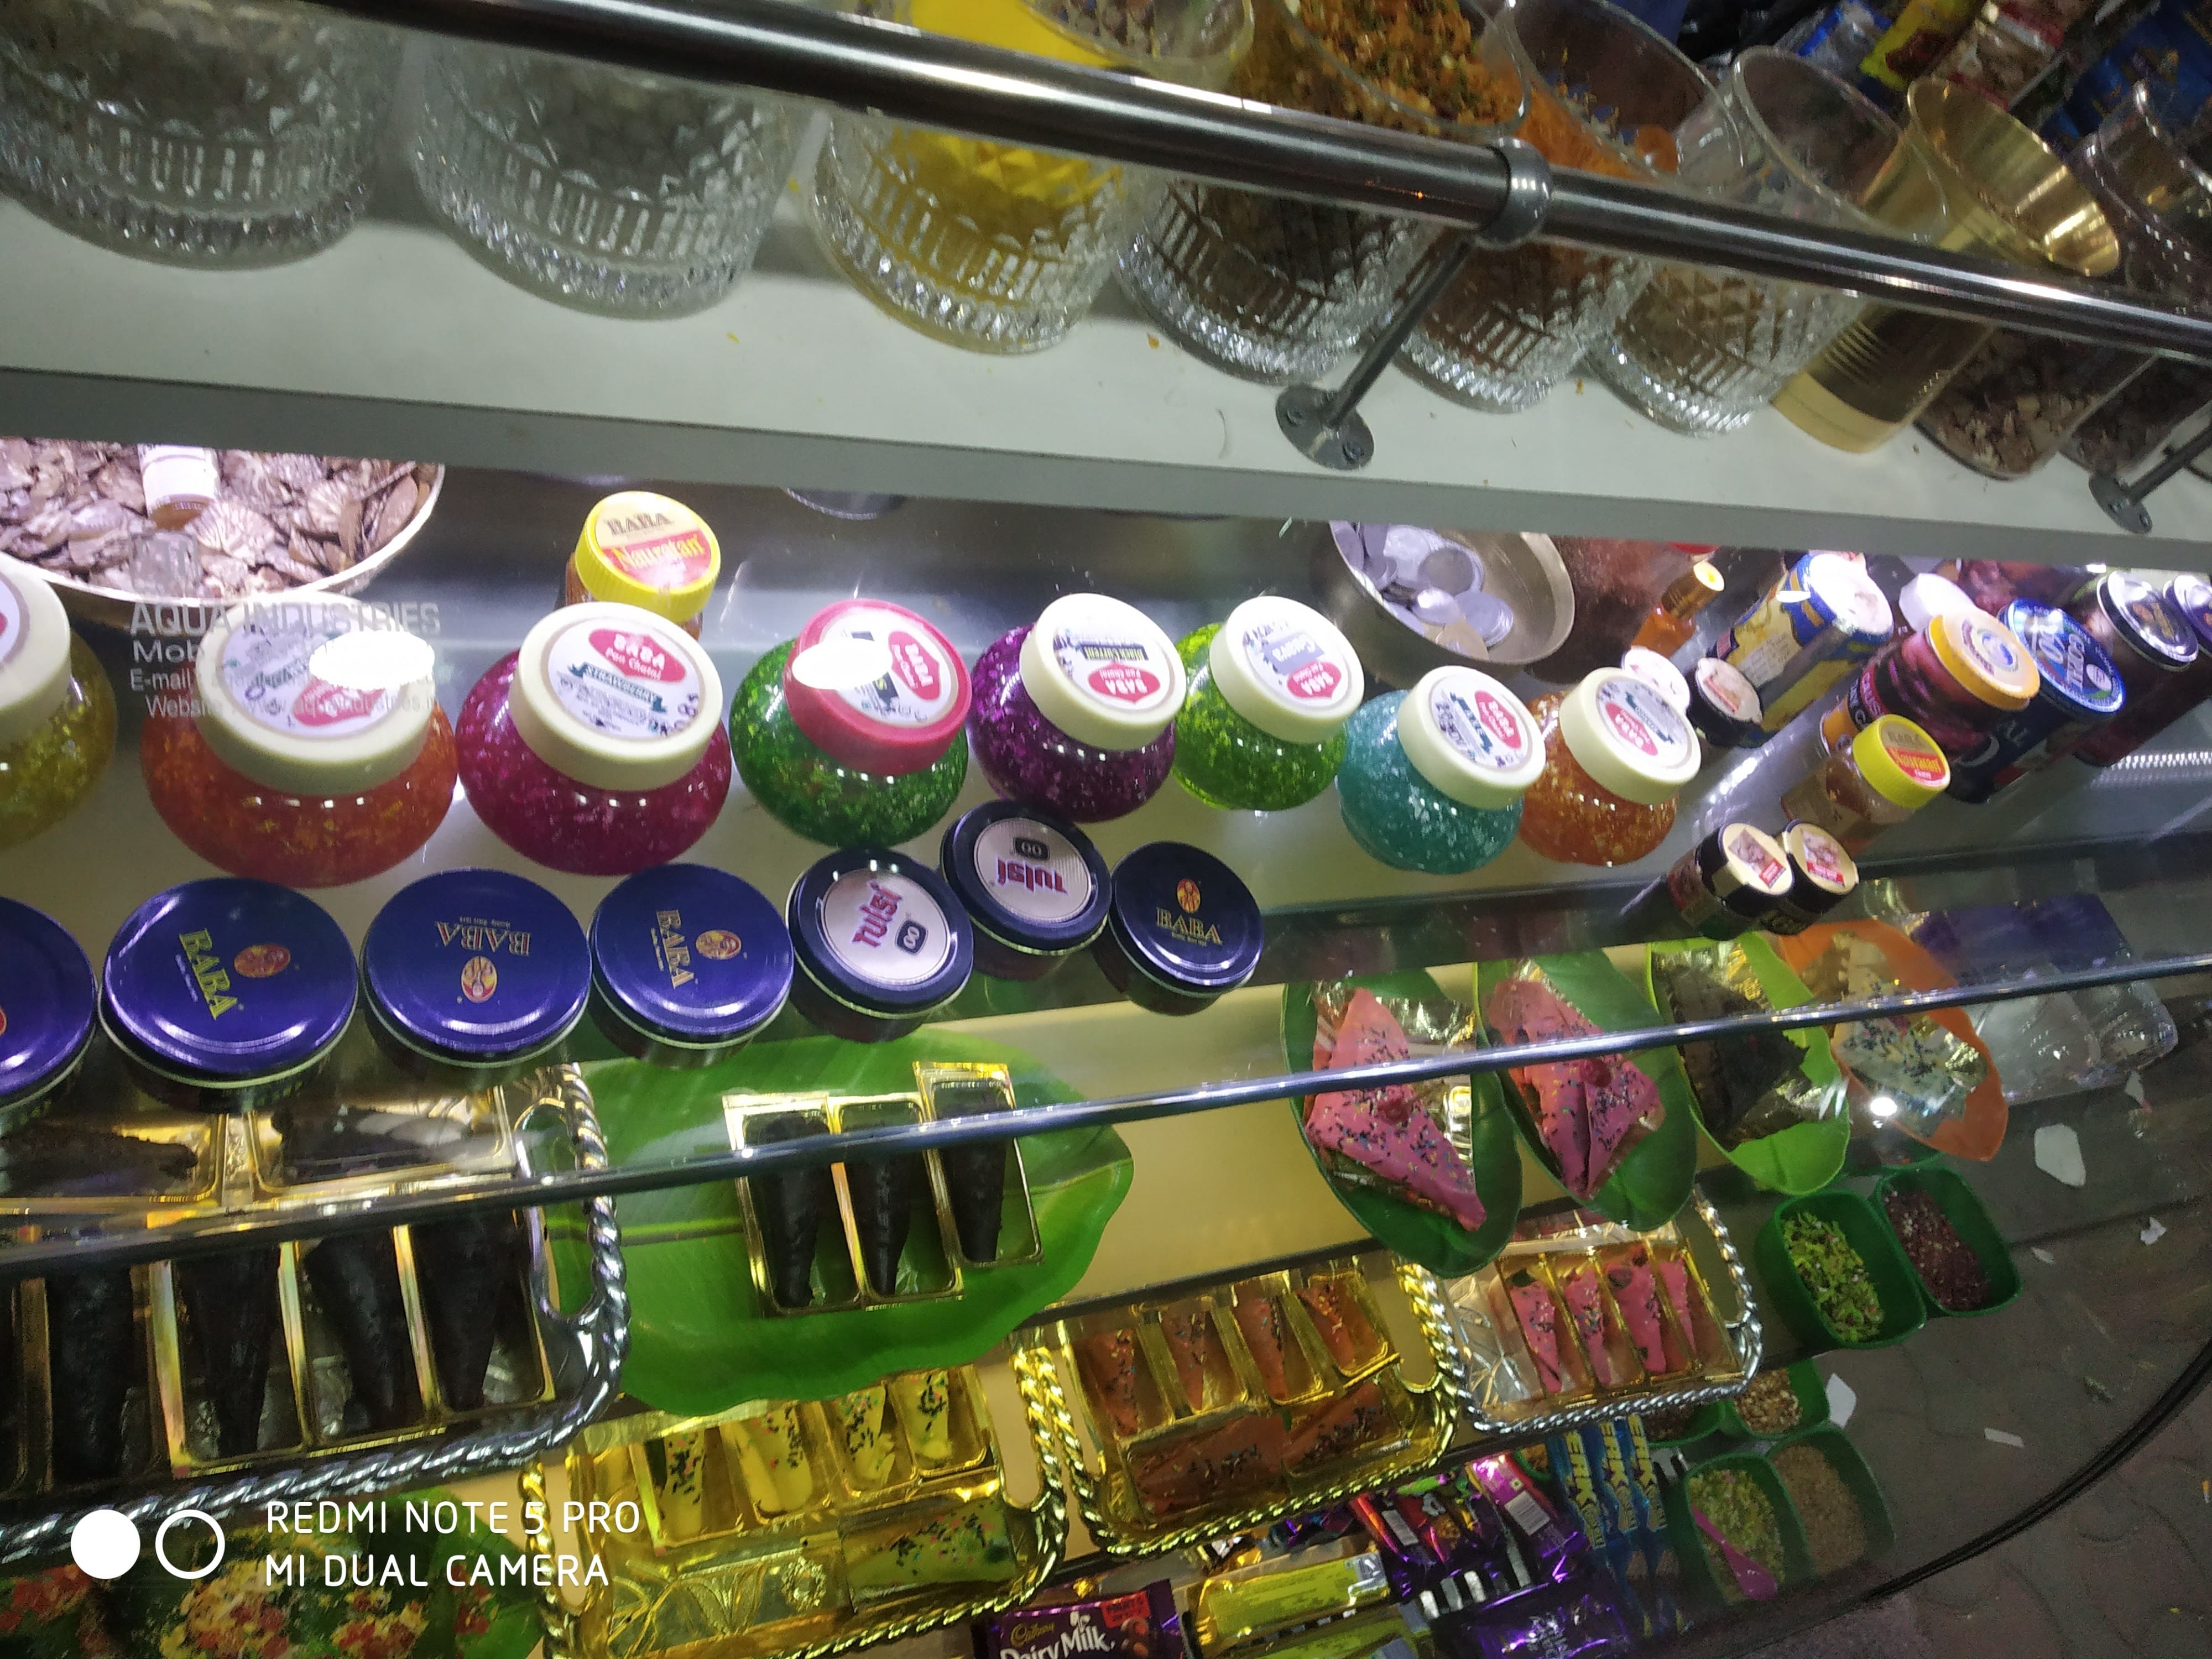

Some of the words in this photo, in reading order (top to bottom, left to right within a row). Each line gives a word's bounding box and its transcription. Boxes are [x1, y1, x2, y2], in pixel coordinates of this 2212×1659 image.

[129, 602, 231, 636] AQUA
[434, 920, 531, 957] BABA
[1156, 906, 1223, 946] BABA
[656, 909, 695, 990] BABA
[179, 927, 238, 1021] BABA
[1060, 1624, 1112, 1658] Milk
